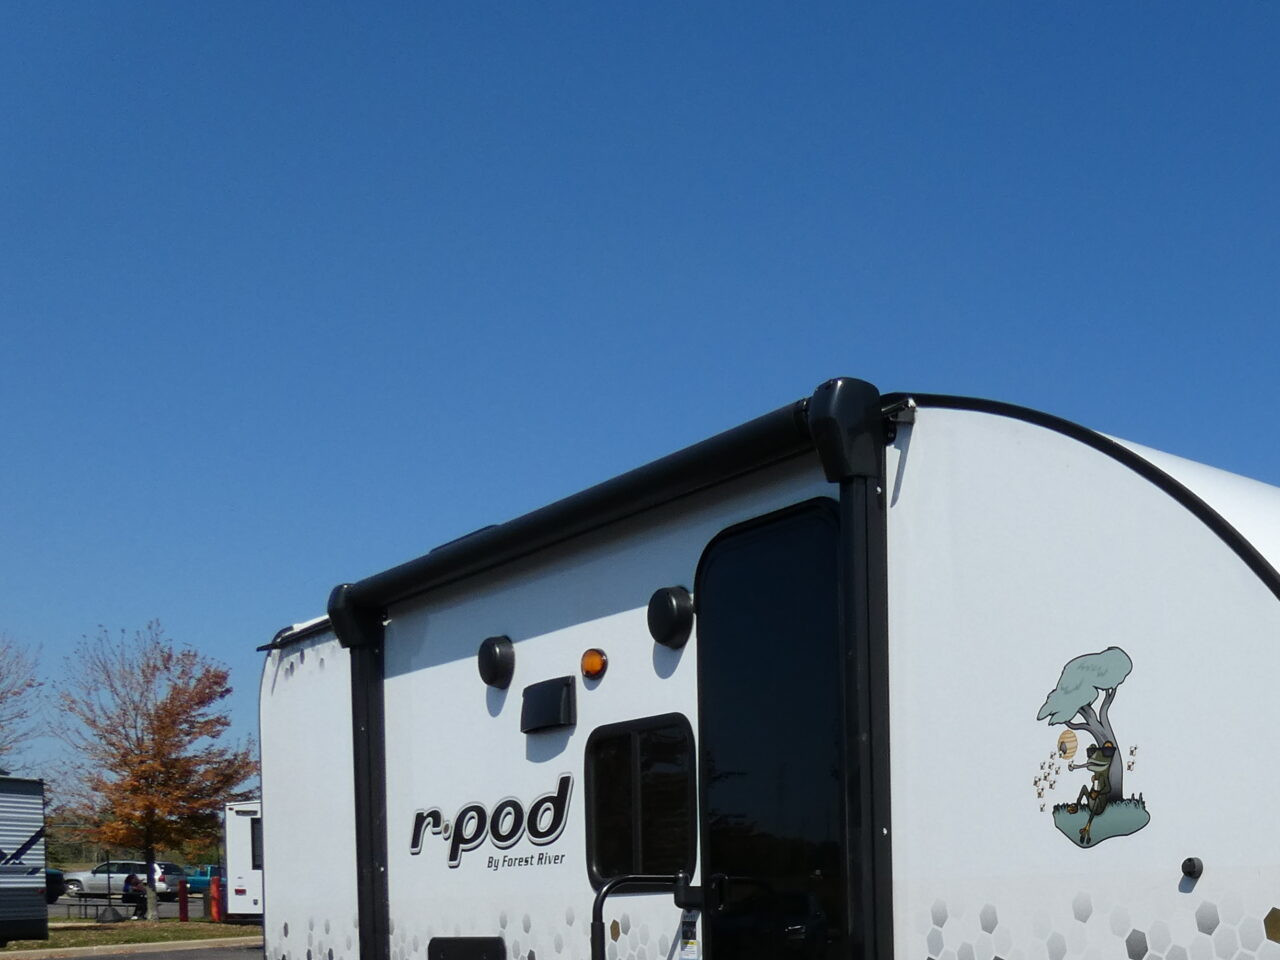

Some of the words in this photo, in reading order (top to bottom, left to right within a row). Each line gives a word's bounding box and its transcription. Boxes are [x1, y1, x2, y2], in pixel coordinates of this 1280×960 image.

[487, 856, 500, 872] By
[501, 854, 535, 868] Forest
[536, 851, 566, 866] River
